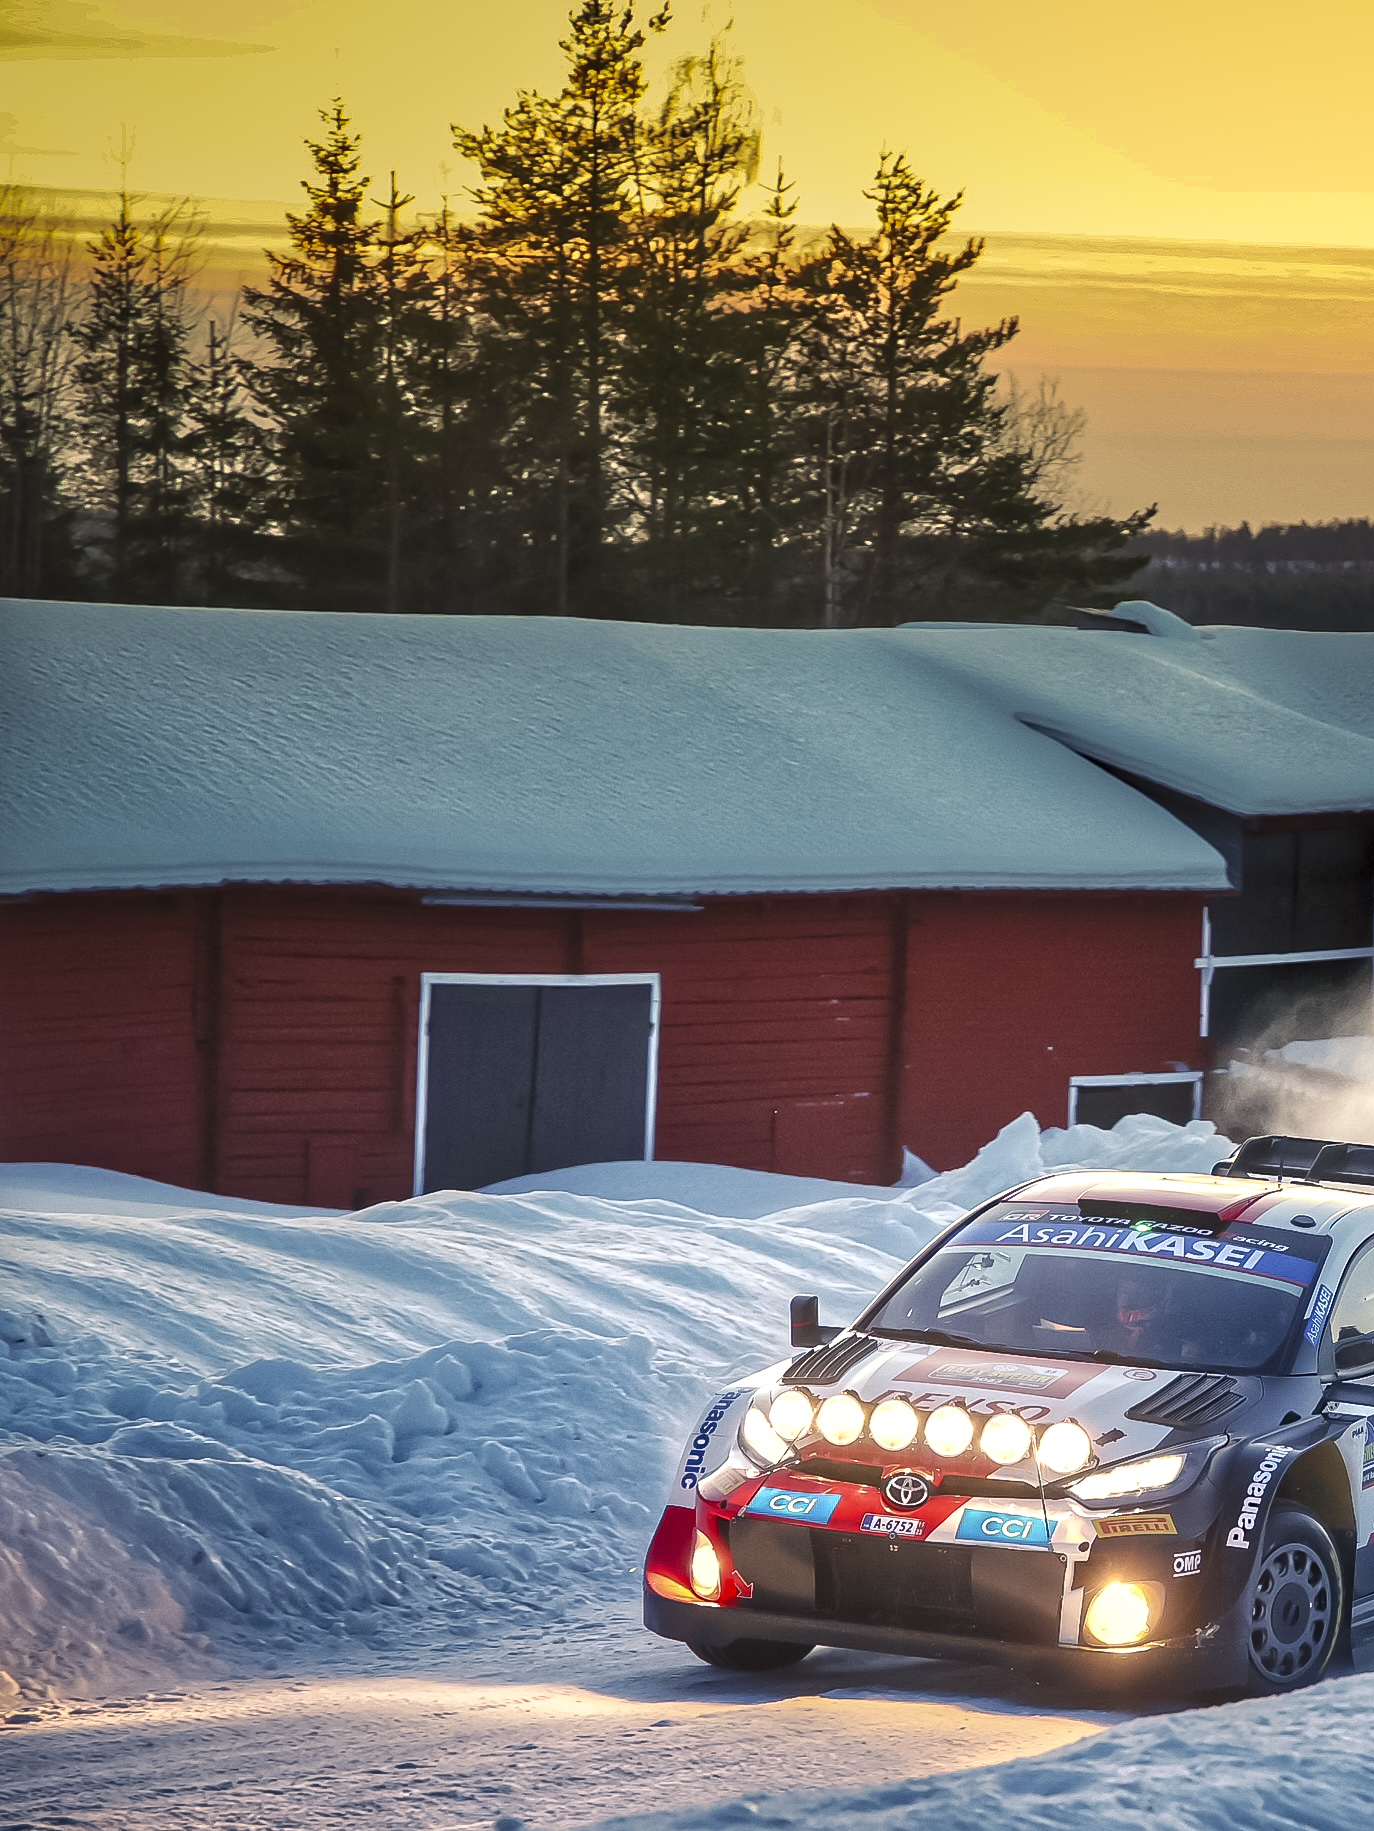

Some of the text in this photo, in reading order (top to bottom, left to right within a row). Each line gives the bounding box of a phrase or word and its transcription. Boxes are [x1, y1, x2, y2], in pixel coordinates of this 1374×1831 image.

[1049, 1214, 1131, 1225] TOYOTA
[1131, 1220, 1214, 1236] GAZOO
[995, 1223, 1266, 1270] AsahiKASEI
[1306, 1286, 1332, 1345] AsahiKASEI
[768, 1494, 818, 1514] CCI
[1226, 1445, 1294, 1549] Panasonic
[873, 1518, 914, 1533] A-6752
[980, 1518, 1033, 1539] CCI
[1099, 1517, 1170, 1534] PIRELLI
[1173, 1555, 1201, 1573] OMP
